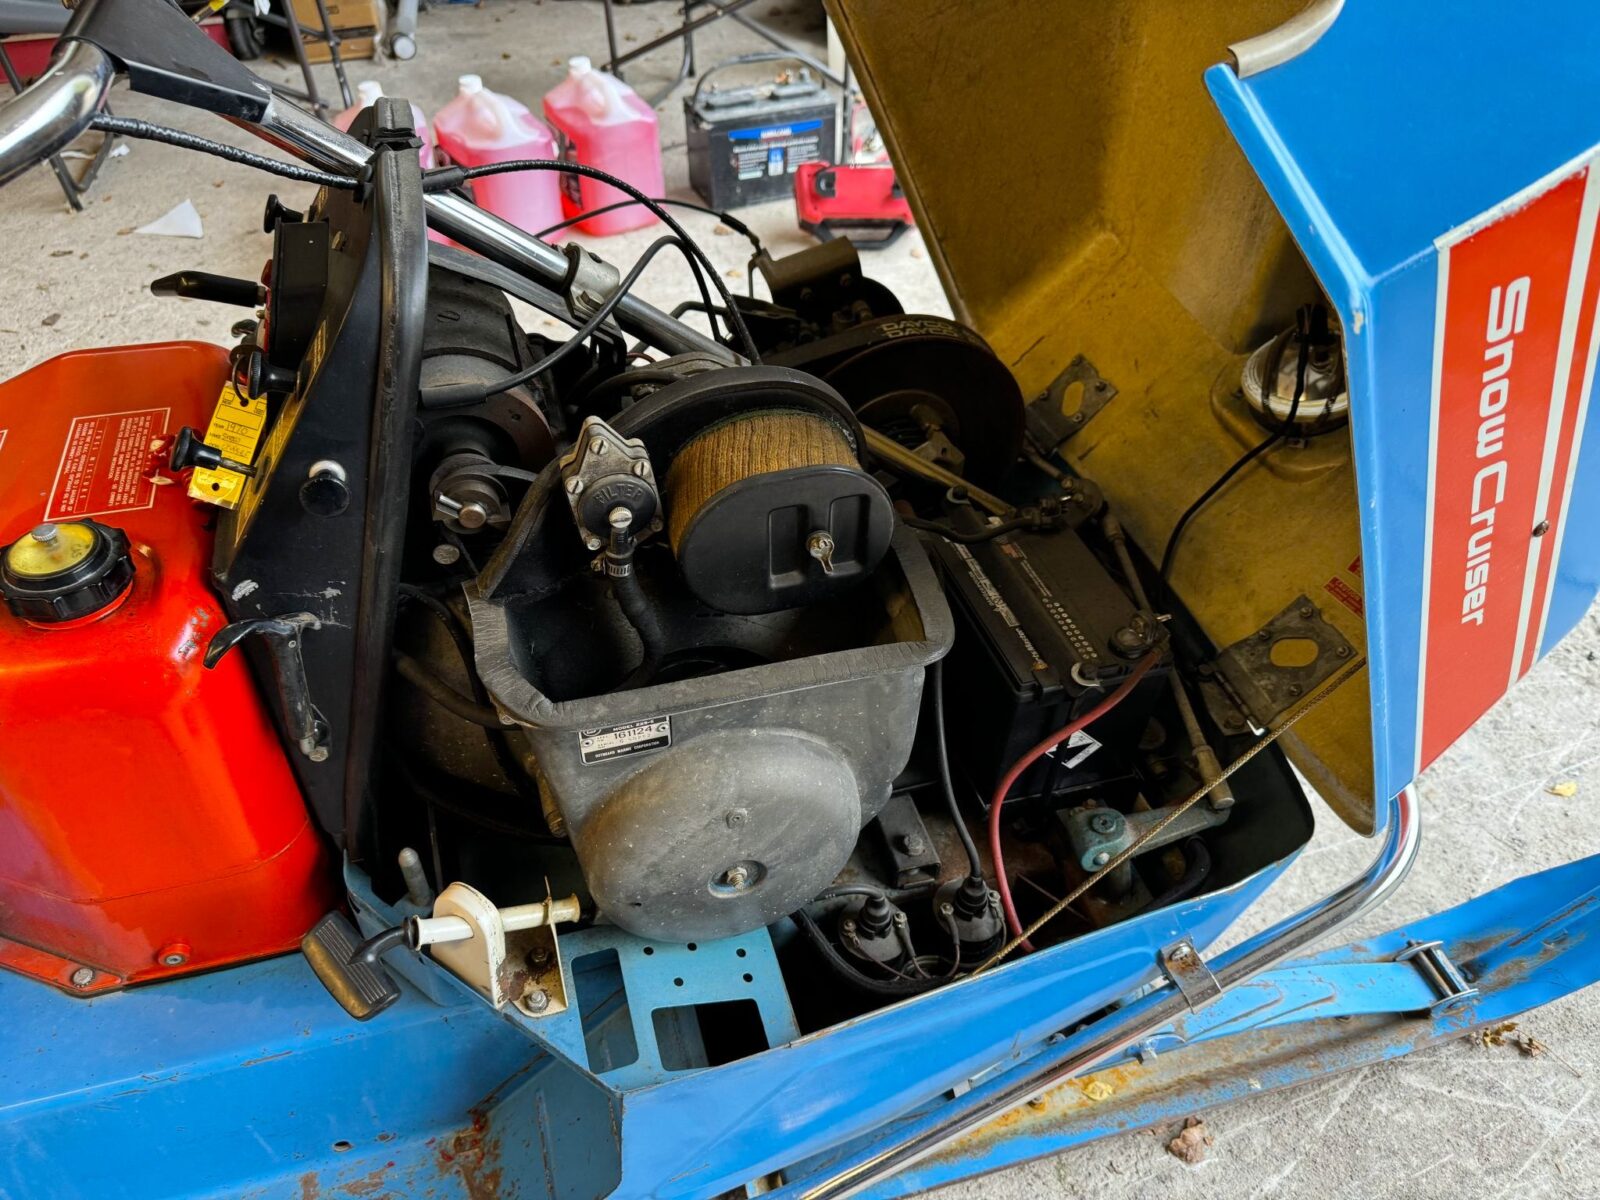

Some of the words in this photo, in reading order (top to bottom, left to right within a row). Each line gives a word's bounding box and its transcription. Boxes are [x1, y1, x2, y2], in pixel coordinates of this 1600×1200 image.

[1476, 276, 1531, 459] Snow
[1461, 460, 1507, 626] Cruiser
[613, 725, 653, 740] 161124
